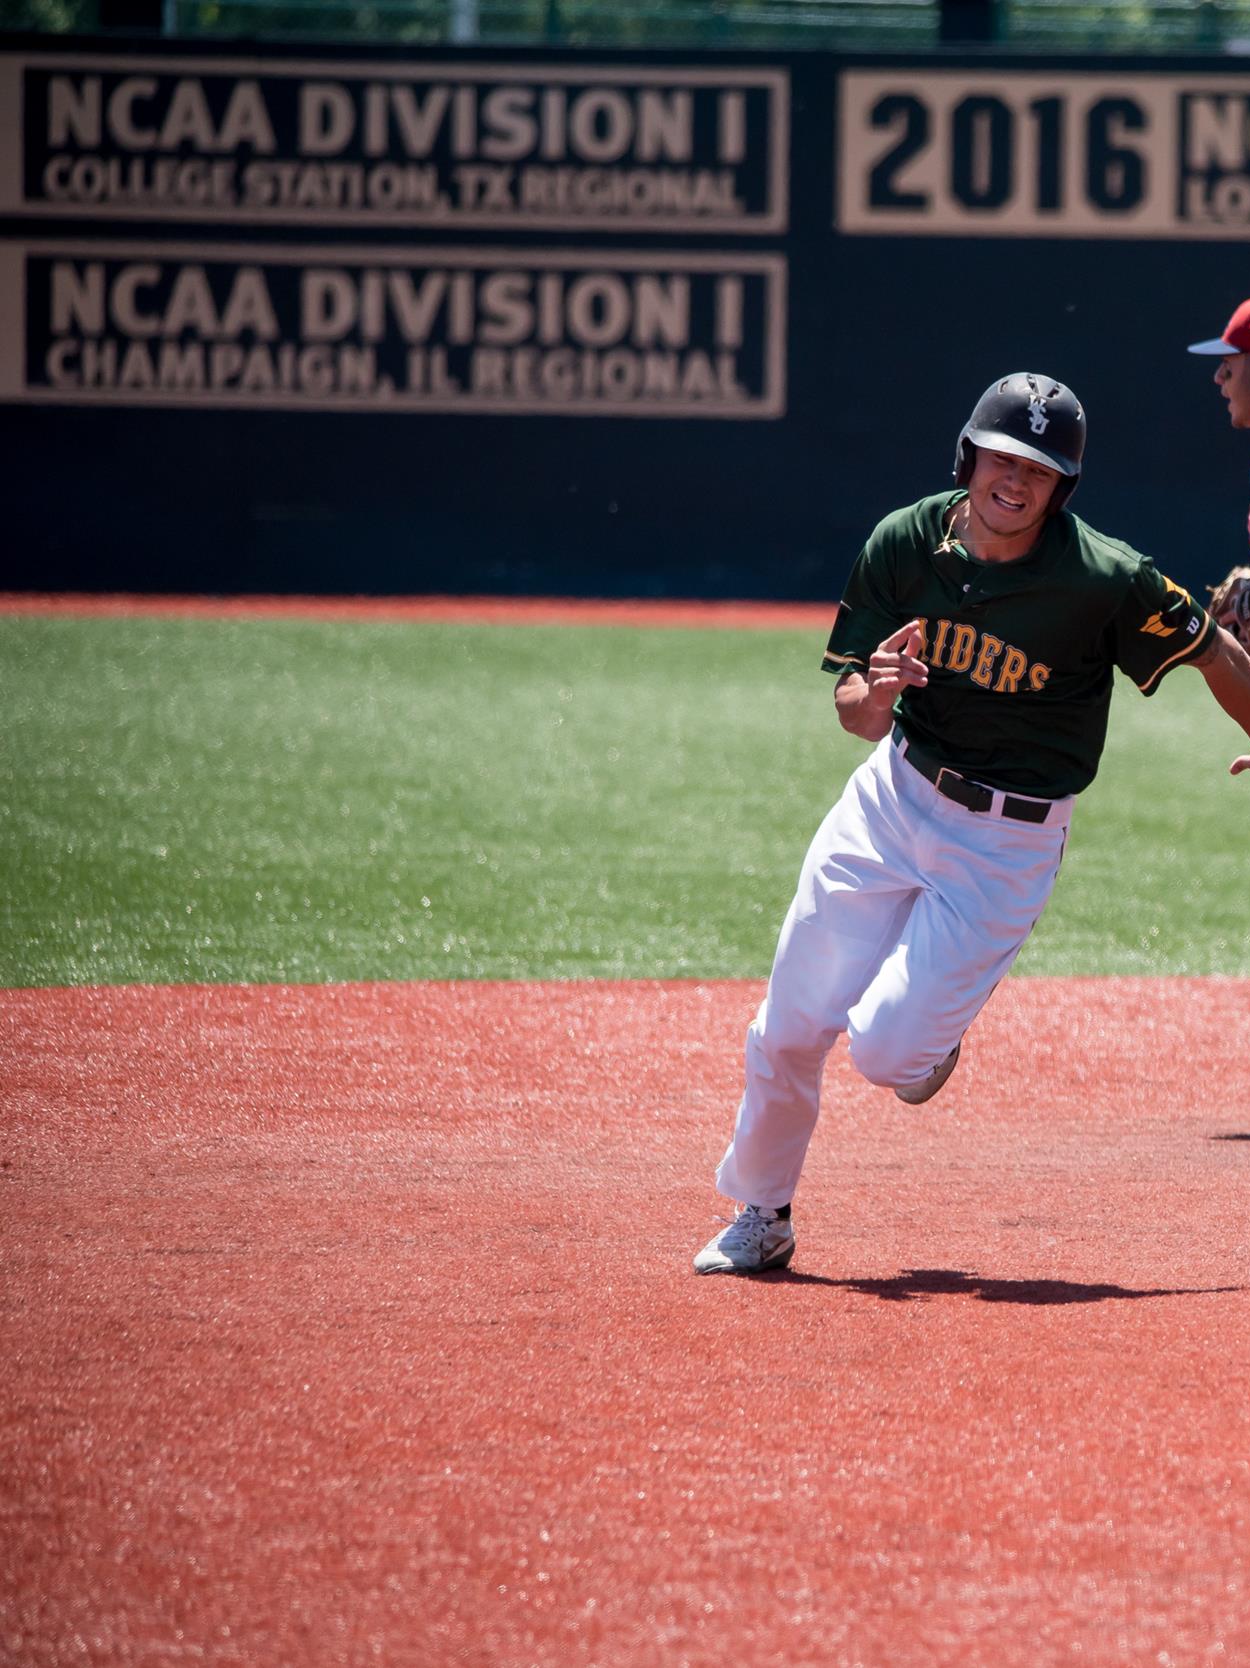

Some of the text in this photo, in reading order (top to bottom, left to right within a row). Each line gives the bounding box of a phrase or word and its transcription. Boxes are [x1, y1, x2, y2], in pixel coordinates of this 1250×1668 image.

[47, 74, 747, 164] NCAA DIVISION I
[866, 90, 1149, 215] 2016
[43, 154, 235, 203] COLLEGE
[454, 167, 513, 209] TX
[521, 167, 744, 216] REGIONAL
[48, 260, 744, 350] NCAA DIVISION I
[407, 345, 461, 397] IL
[470, 346, 748, 402] REGIONAL
[916, 617, 1052, 693] IDERS
